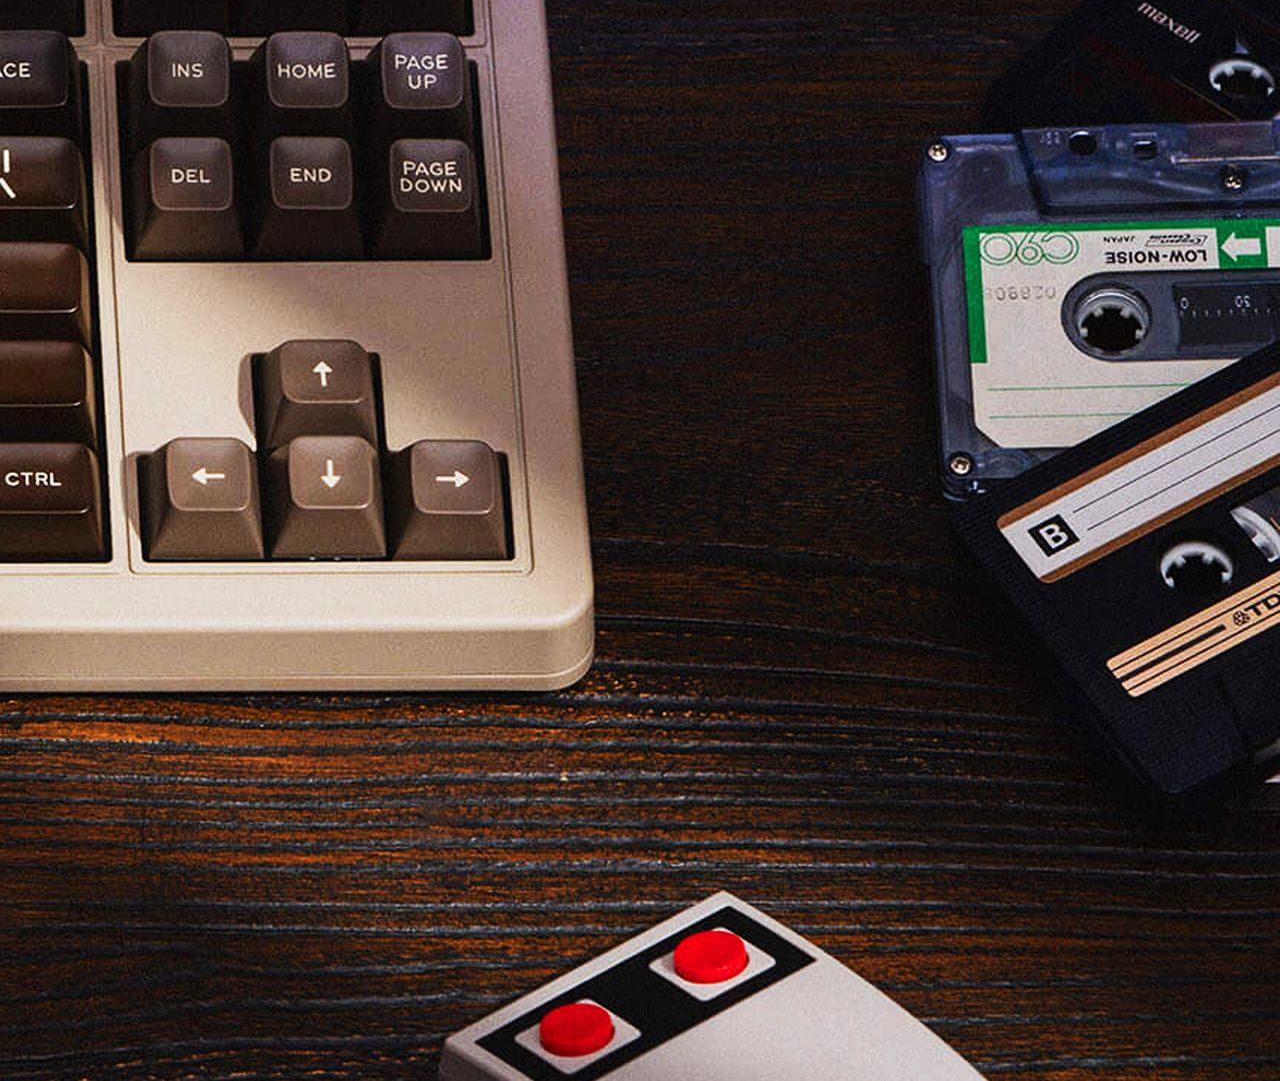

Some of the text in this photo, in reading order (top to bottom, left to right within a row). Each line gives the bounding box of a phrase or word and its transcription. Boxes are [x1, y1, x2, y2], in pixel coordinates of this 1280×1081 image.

[1137, 1, 1202, 45] maxell
[172, 63, 204, 78] INS
[277, 62, 336, 79] HOME
[395, 53, 449, 71] PAGE
[407, 73, 437, 90] UP
[171, 160, 457, 184] DEL END PAGE
[400, 177, 462, 193] DOWN
[979, 230, 1080, 267] C90
[1104, 250, 1208, 265] LOW-NOISE
[4, 471, 62, 487] CTRL
[1038, 523, 1070, 550] B
[1243, 590, 1280, 617] TD
